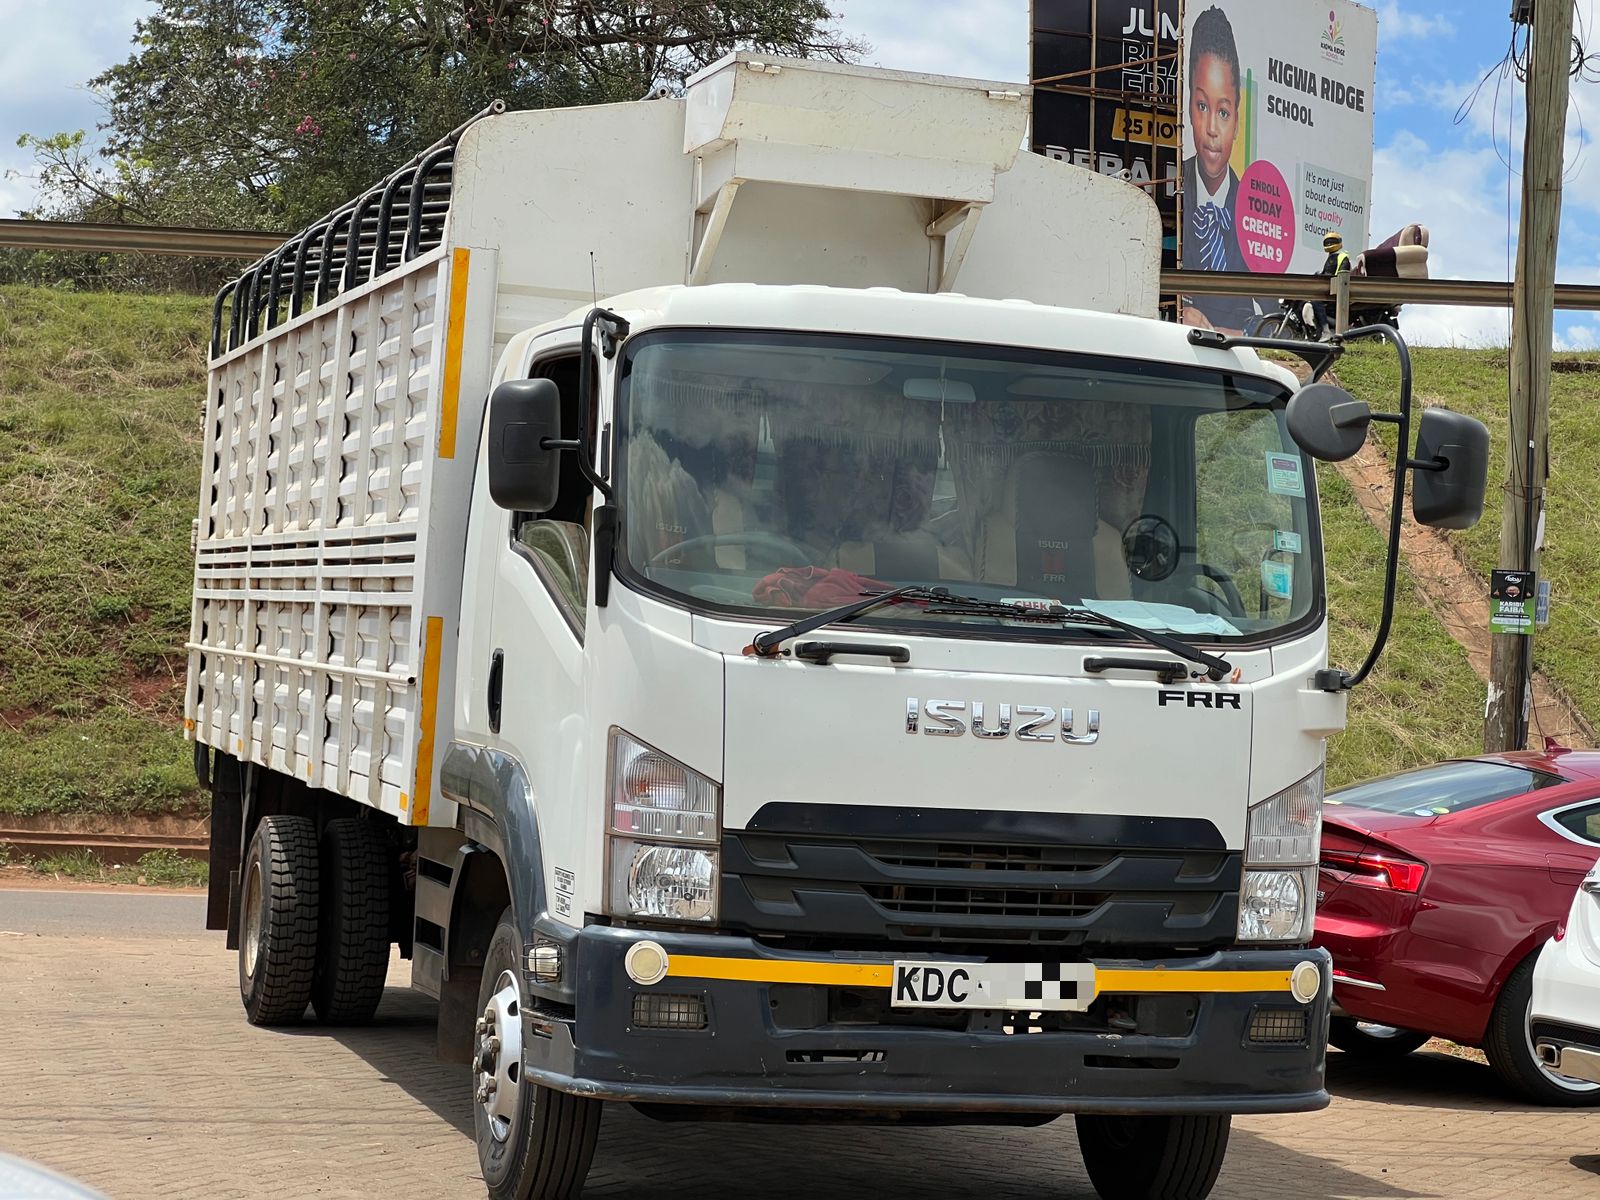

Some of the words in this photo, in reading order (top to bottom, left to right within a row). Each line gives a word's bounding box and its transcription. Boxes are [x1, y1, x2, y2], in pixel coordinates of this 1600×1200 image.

[1268, 57, 1318, 97] KIGWA
[1320, 76, 1364, 112] RIDGE
[1267, 94, 1314, 127] SCHOOL
[1250, 178, 1281, 197] ENROLL
[1305, 171, 1316, 184] It's
[1317, 176, 1330, 188] not
[1330, 178, 1345, 193] just
[1248, 196, 1282, 218] TODAY
[1305, 189, 1326, 203] about
[1327, 196, 1364, 214] education
[1305, 204, 1317, 217] but
[1318, 209, 1343, 226] quality
[1242, 216, 1282, 240] CRECHE
[1305, 222, 1335, 236] educat
[1247, 240, 1275, 260] YEAR
[1276, 250, 1283, 262] 9
[1039, 540, 1069, 549] ISUZU
[1158, 690, 1241, 710] FRR
[905, 697, 1100, 745] ISUZU
[897, 966, 970, 1003] KDC
